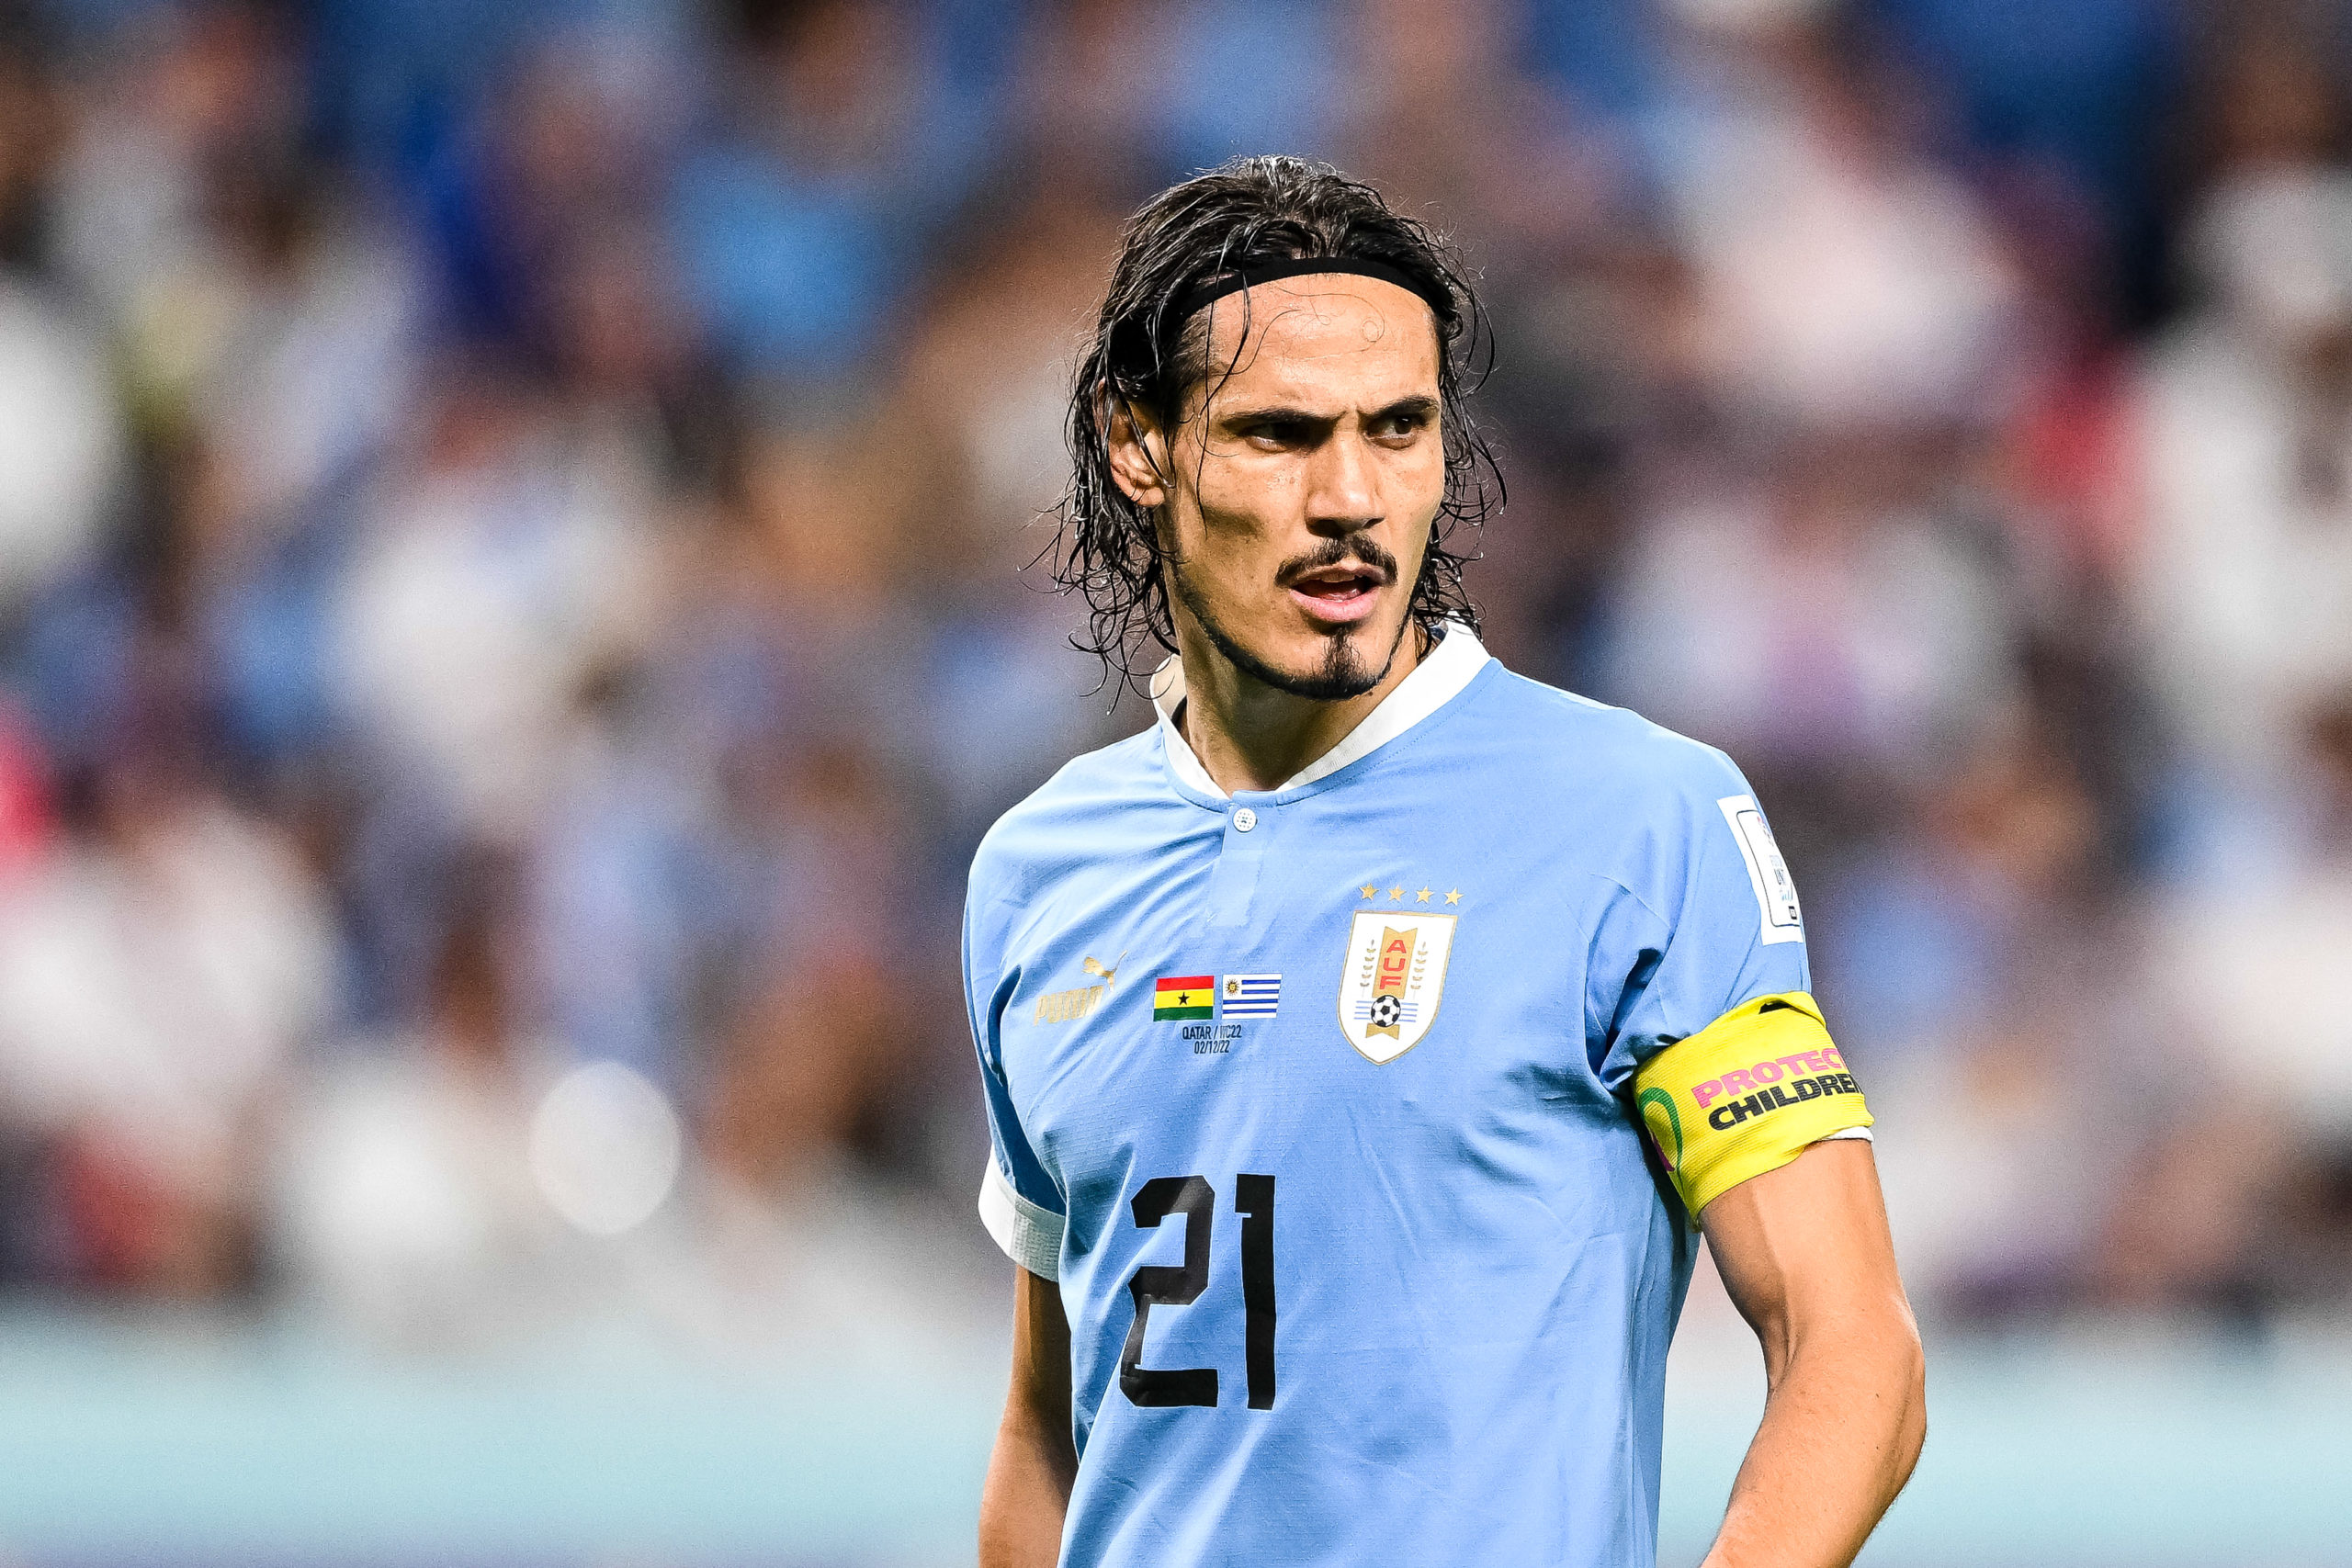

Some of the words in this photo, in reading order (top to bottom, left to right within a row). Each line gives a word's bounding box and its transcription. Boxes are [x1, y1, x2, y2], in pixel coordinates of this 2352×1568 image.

[1379, 939, 1407, 990] AUF
[1182, 1025, 1212, 1040] QATAR
[1193, 1039, 1231, 1055] 02/12/22
[1690, 1047, 1848, 1110] PROTEC
[1119, 1173, 1277, 1411] 21
